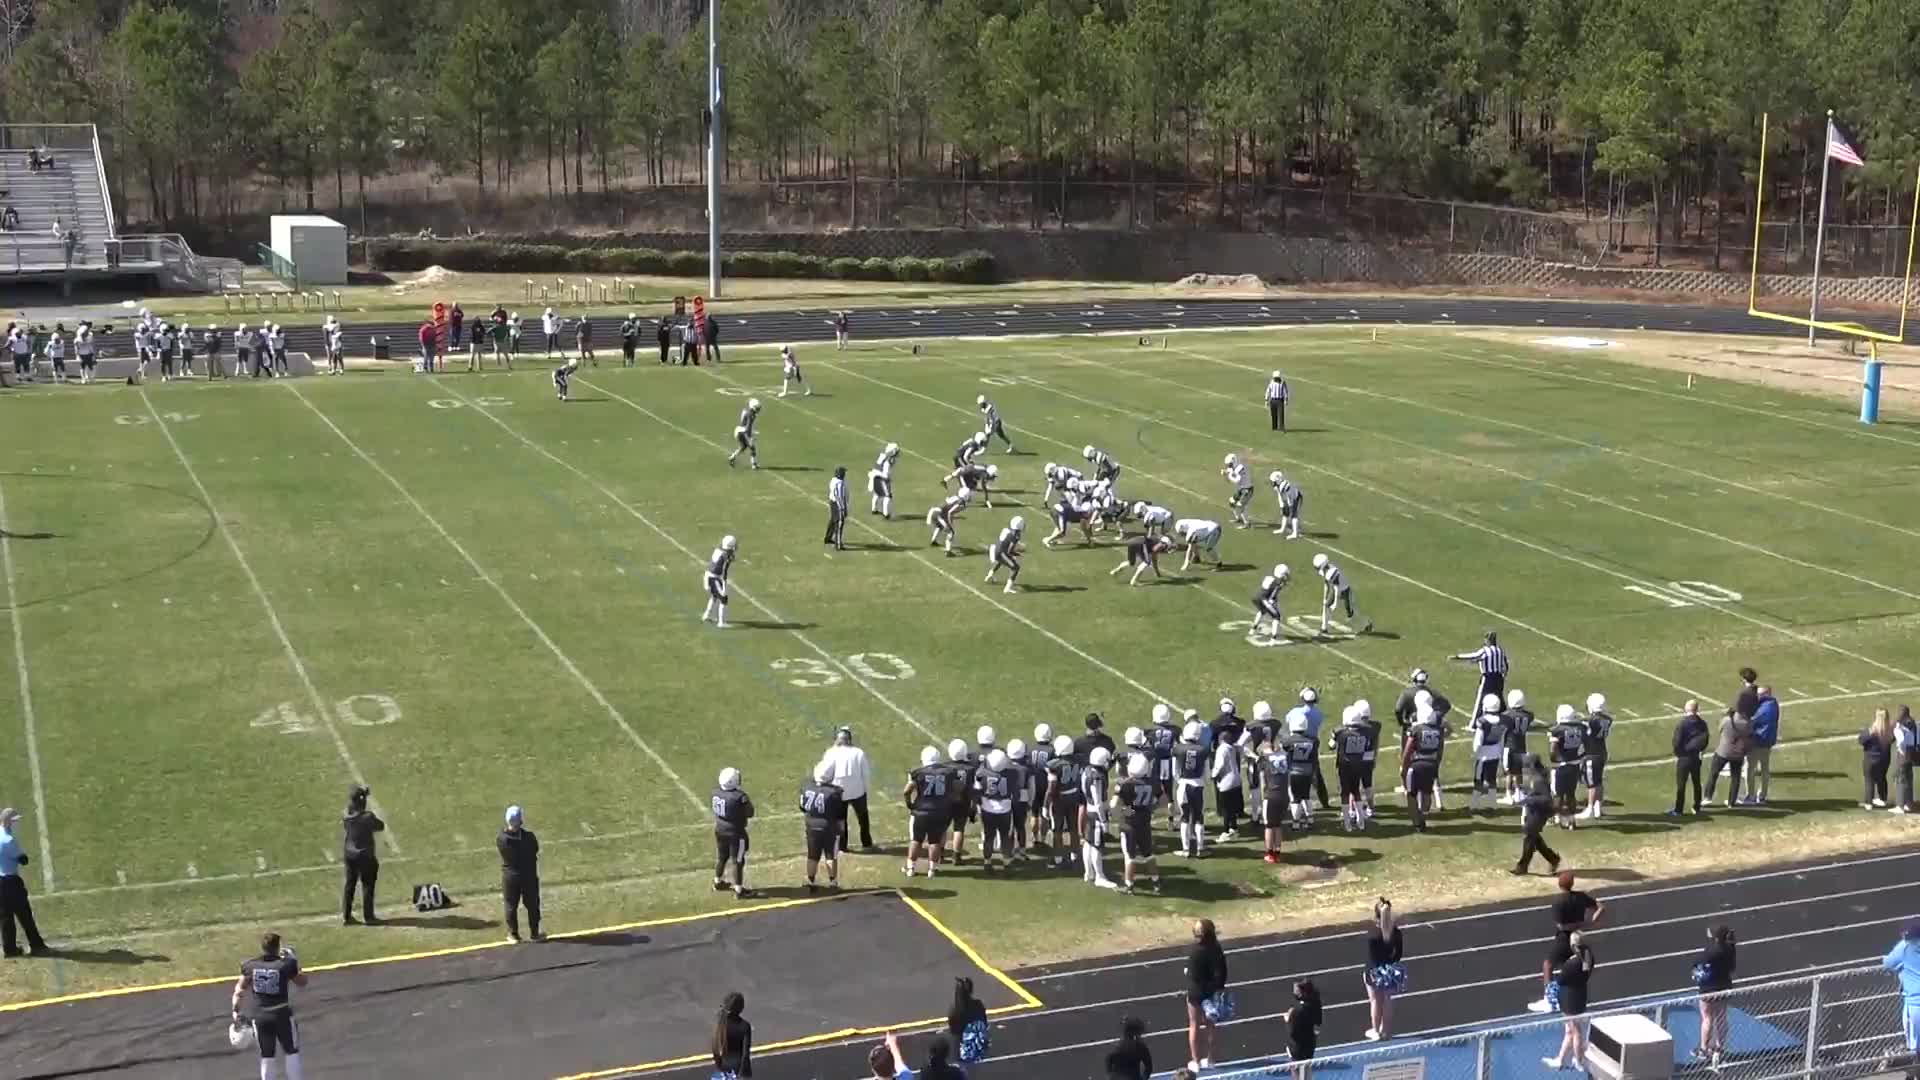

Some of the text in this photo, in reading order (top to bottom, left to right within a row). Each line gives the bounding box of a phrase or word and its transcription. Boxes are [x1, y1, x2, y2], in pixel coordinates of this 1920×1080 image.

[769, 652, 916, 687] 30
[249, 694, 402, 734] 40
[804, 790, 826, 814] 74
[415, 884, 443, 909] 40
[252, 968, 281, 995] 52
